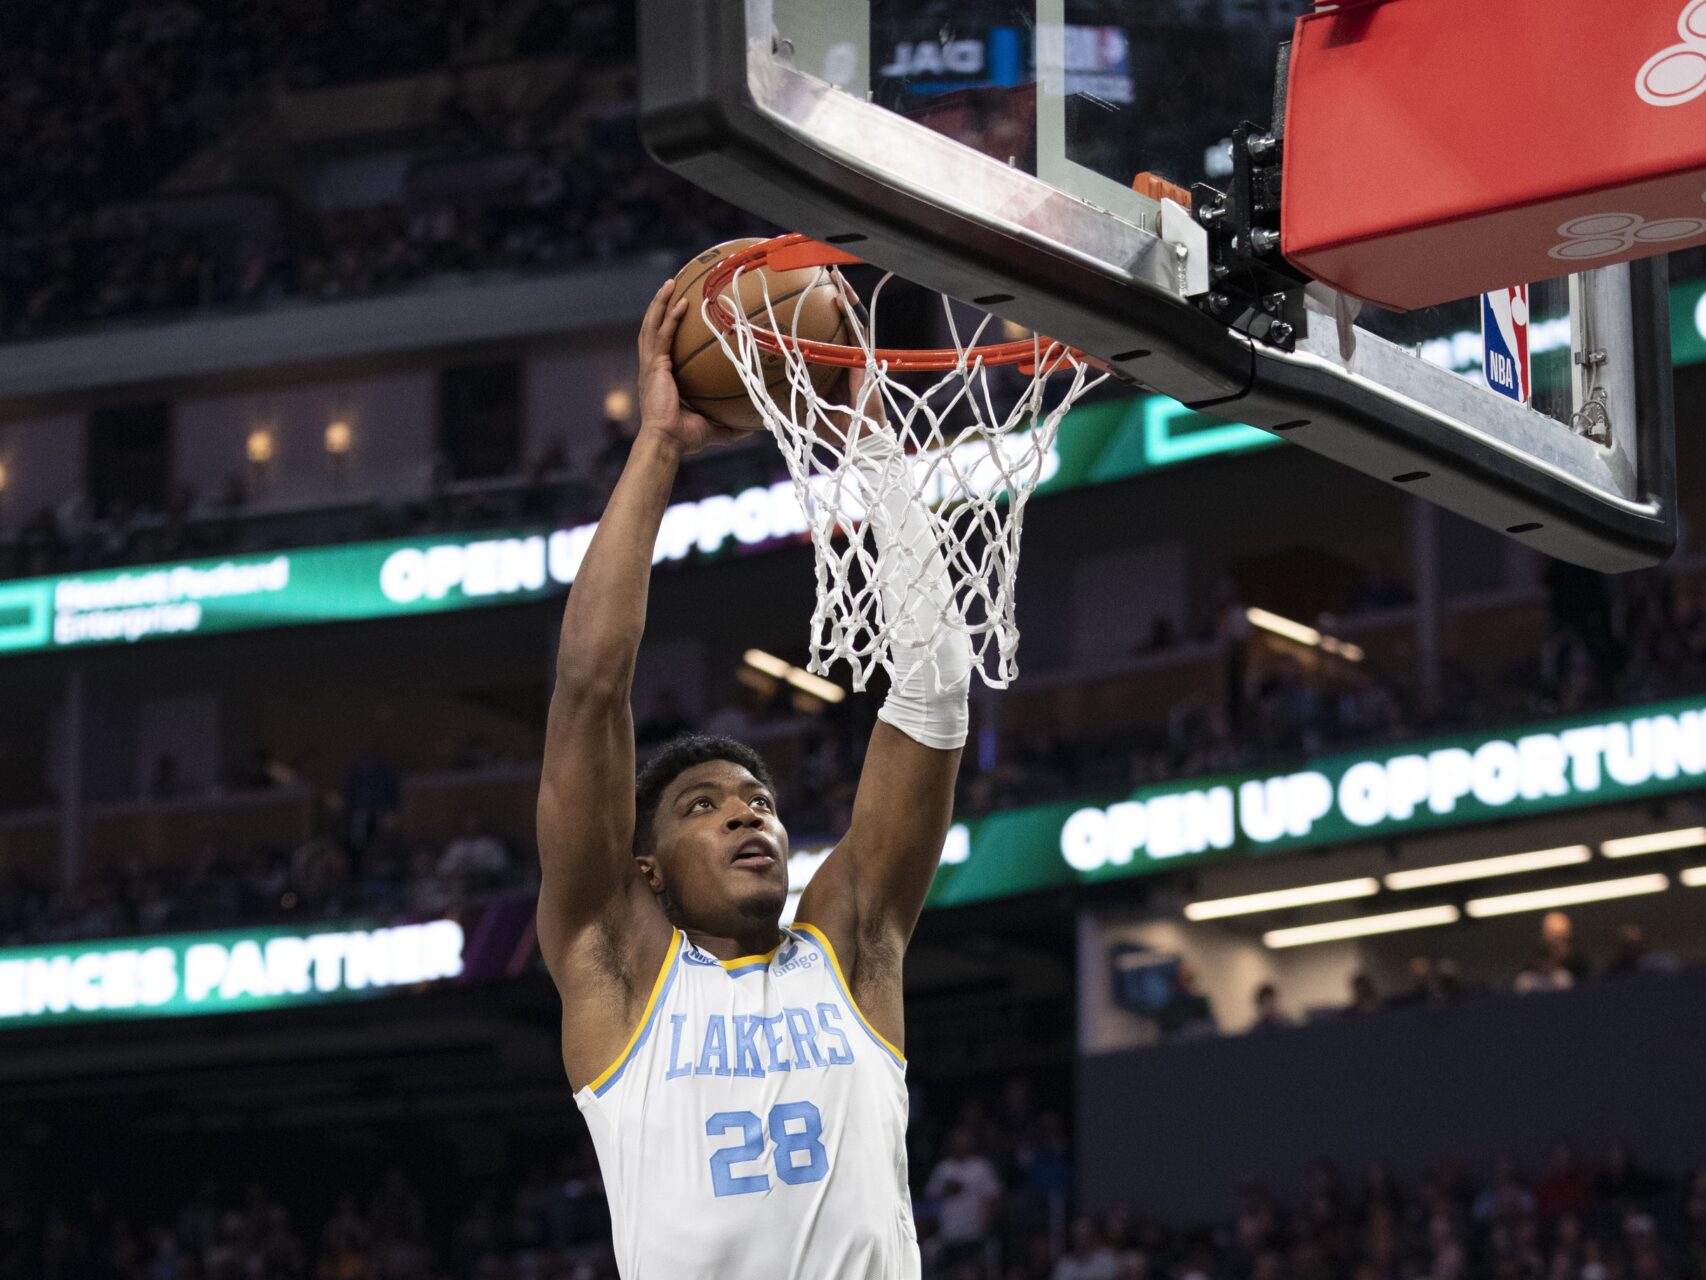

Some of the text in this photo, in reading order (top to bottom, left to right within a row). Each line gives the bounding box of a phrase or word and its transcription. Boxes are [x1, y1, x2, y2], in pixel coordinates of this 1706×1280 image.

[1490, 350, 1513, 390] NBA
[380, 535, 546, 603] OPEN
[1060, 786, 1236, 872] OPEN
[1239, 770, 1334, 843] UP
[184, 919, 465, 1001] PARTNER
[772, 951, 819, 978] bibigo
[665, 1002, 855, 1081] LAKERS
[705, 1101, 830, 1198] 28
